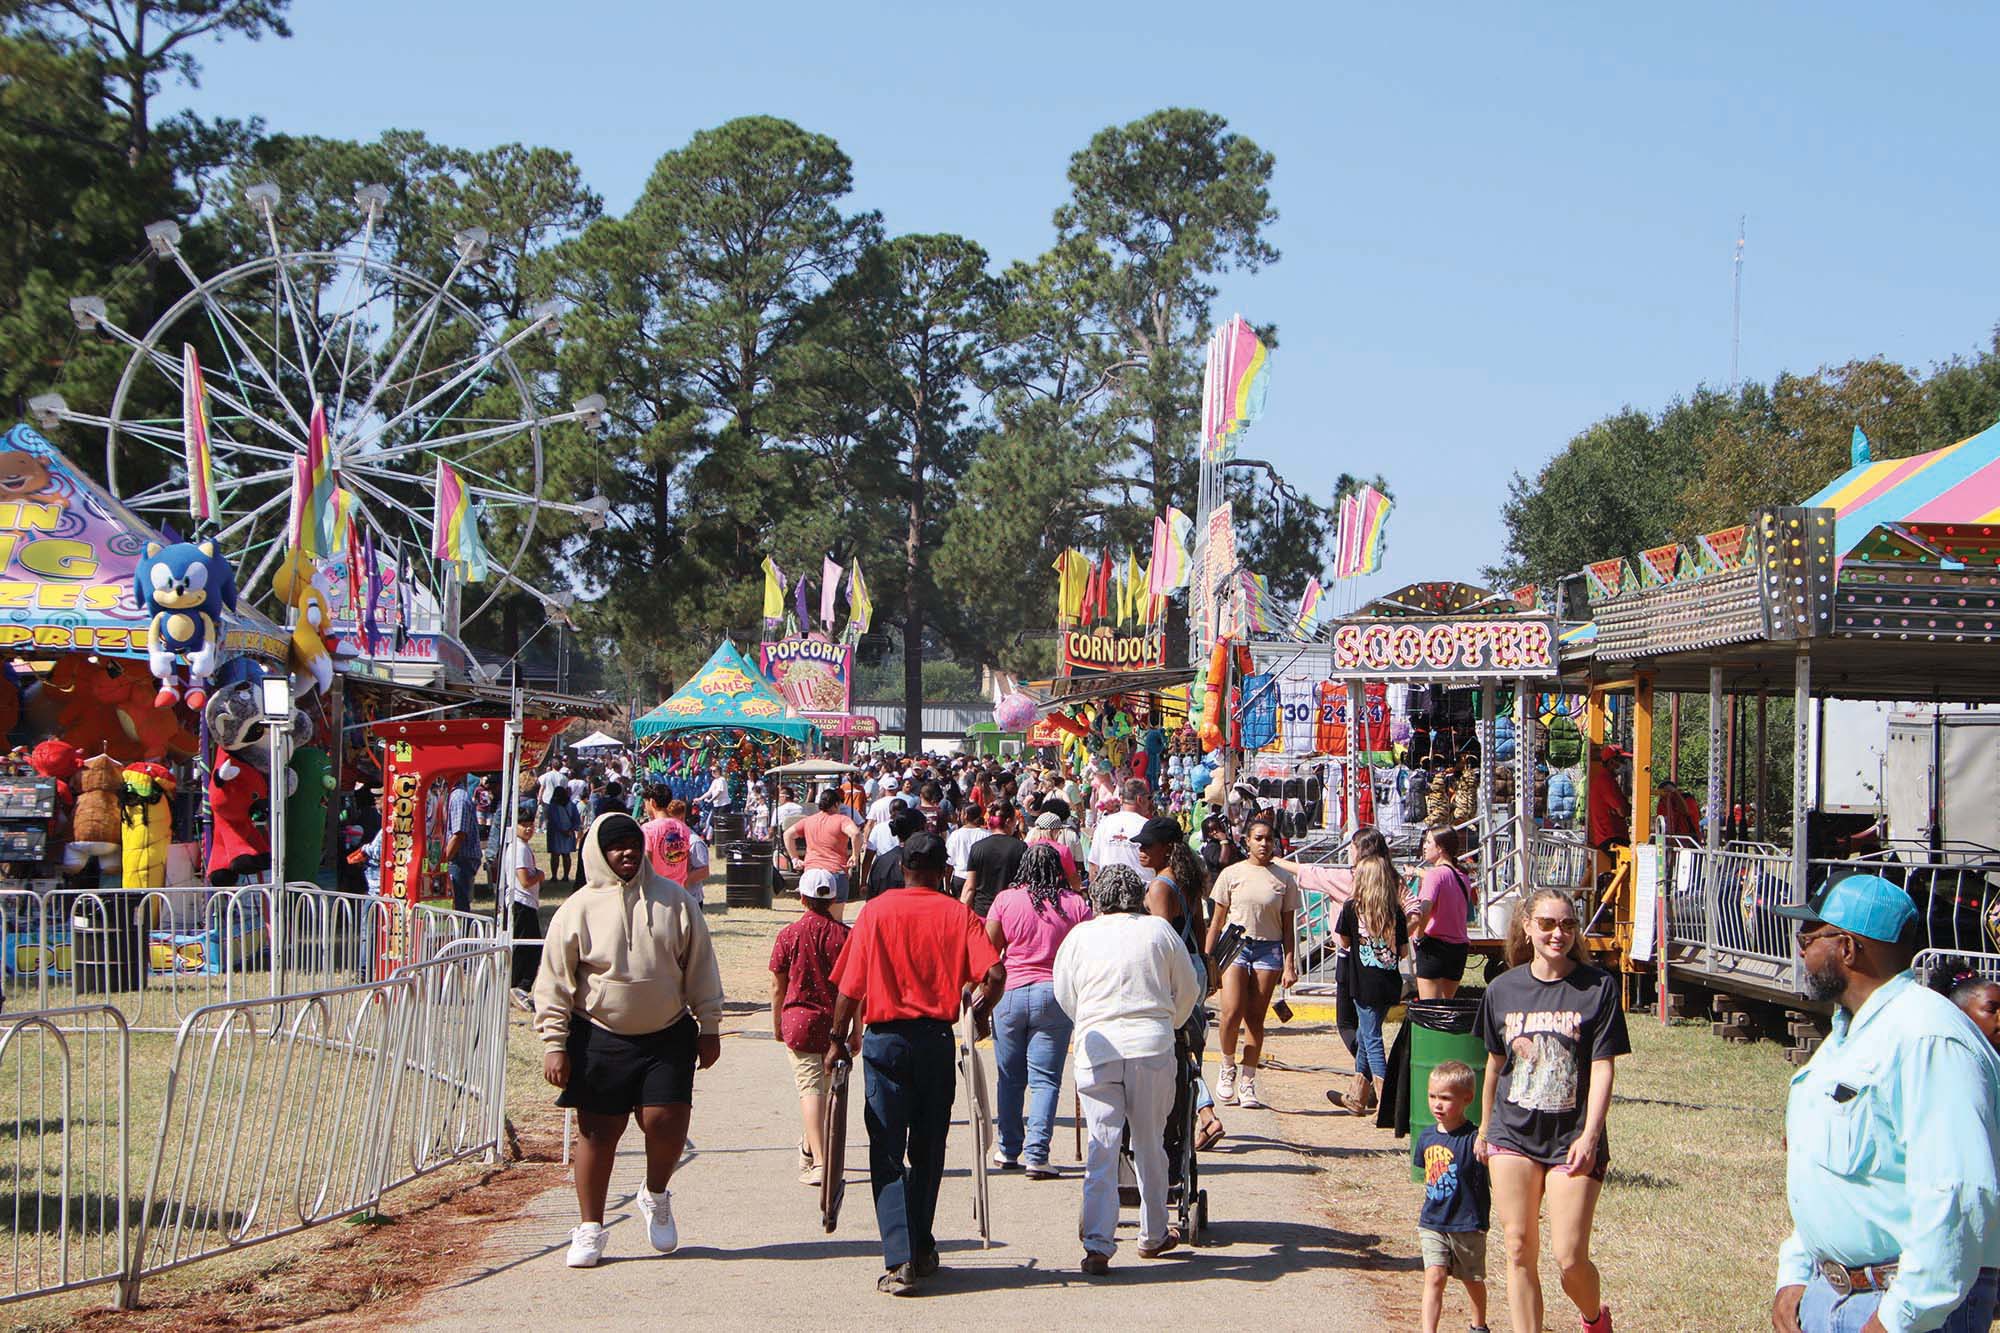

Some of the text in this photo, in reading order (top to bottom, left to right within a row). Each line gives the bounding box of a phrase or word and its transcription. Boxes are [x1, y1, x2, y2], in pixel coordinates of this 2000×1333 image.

[0, 503, 61, 532] IN
[0, 582, 124, 610] ZES
[766, 640, 847, 664] POPCORN
[1069, 632, 1160, 662] CORN DOGS
[1334, 622, 1551, 670] SCOOTER
[702, 679, 753, 694] GAMES
[743, 702, 781, 715] GAMES
[1284, 703, 1310, 722] 30
[1323, 704, 1347, 723] 24
